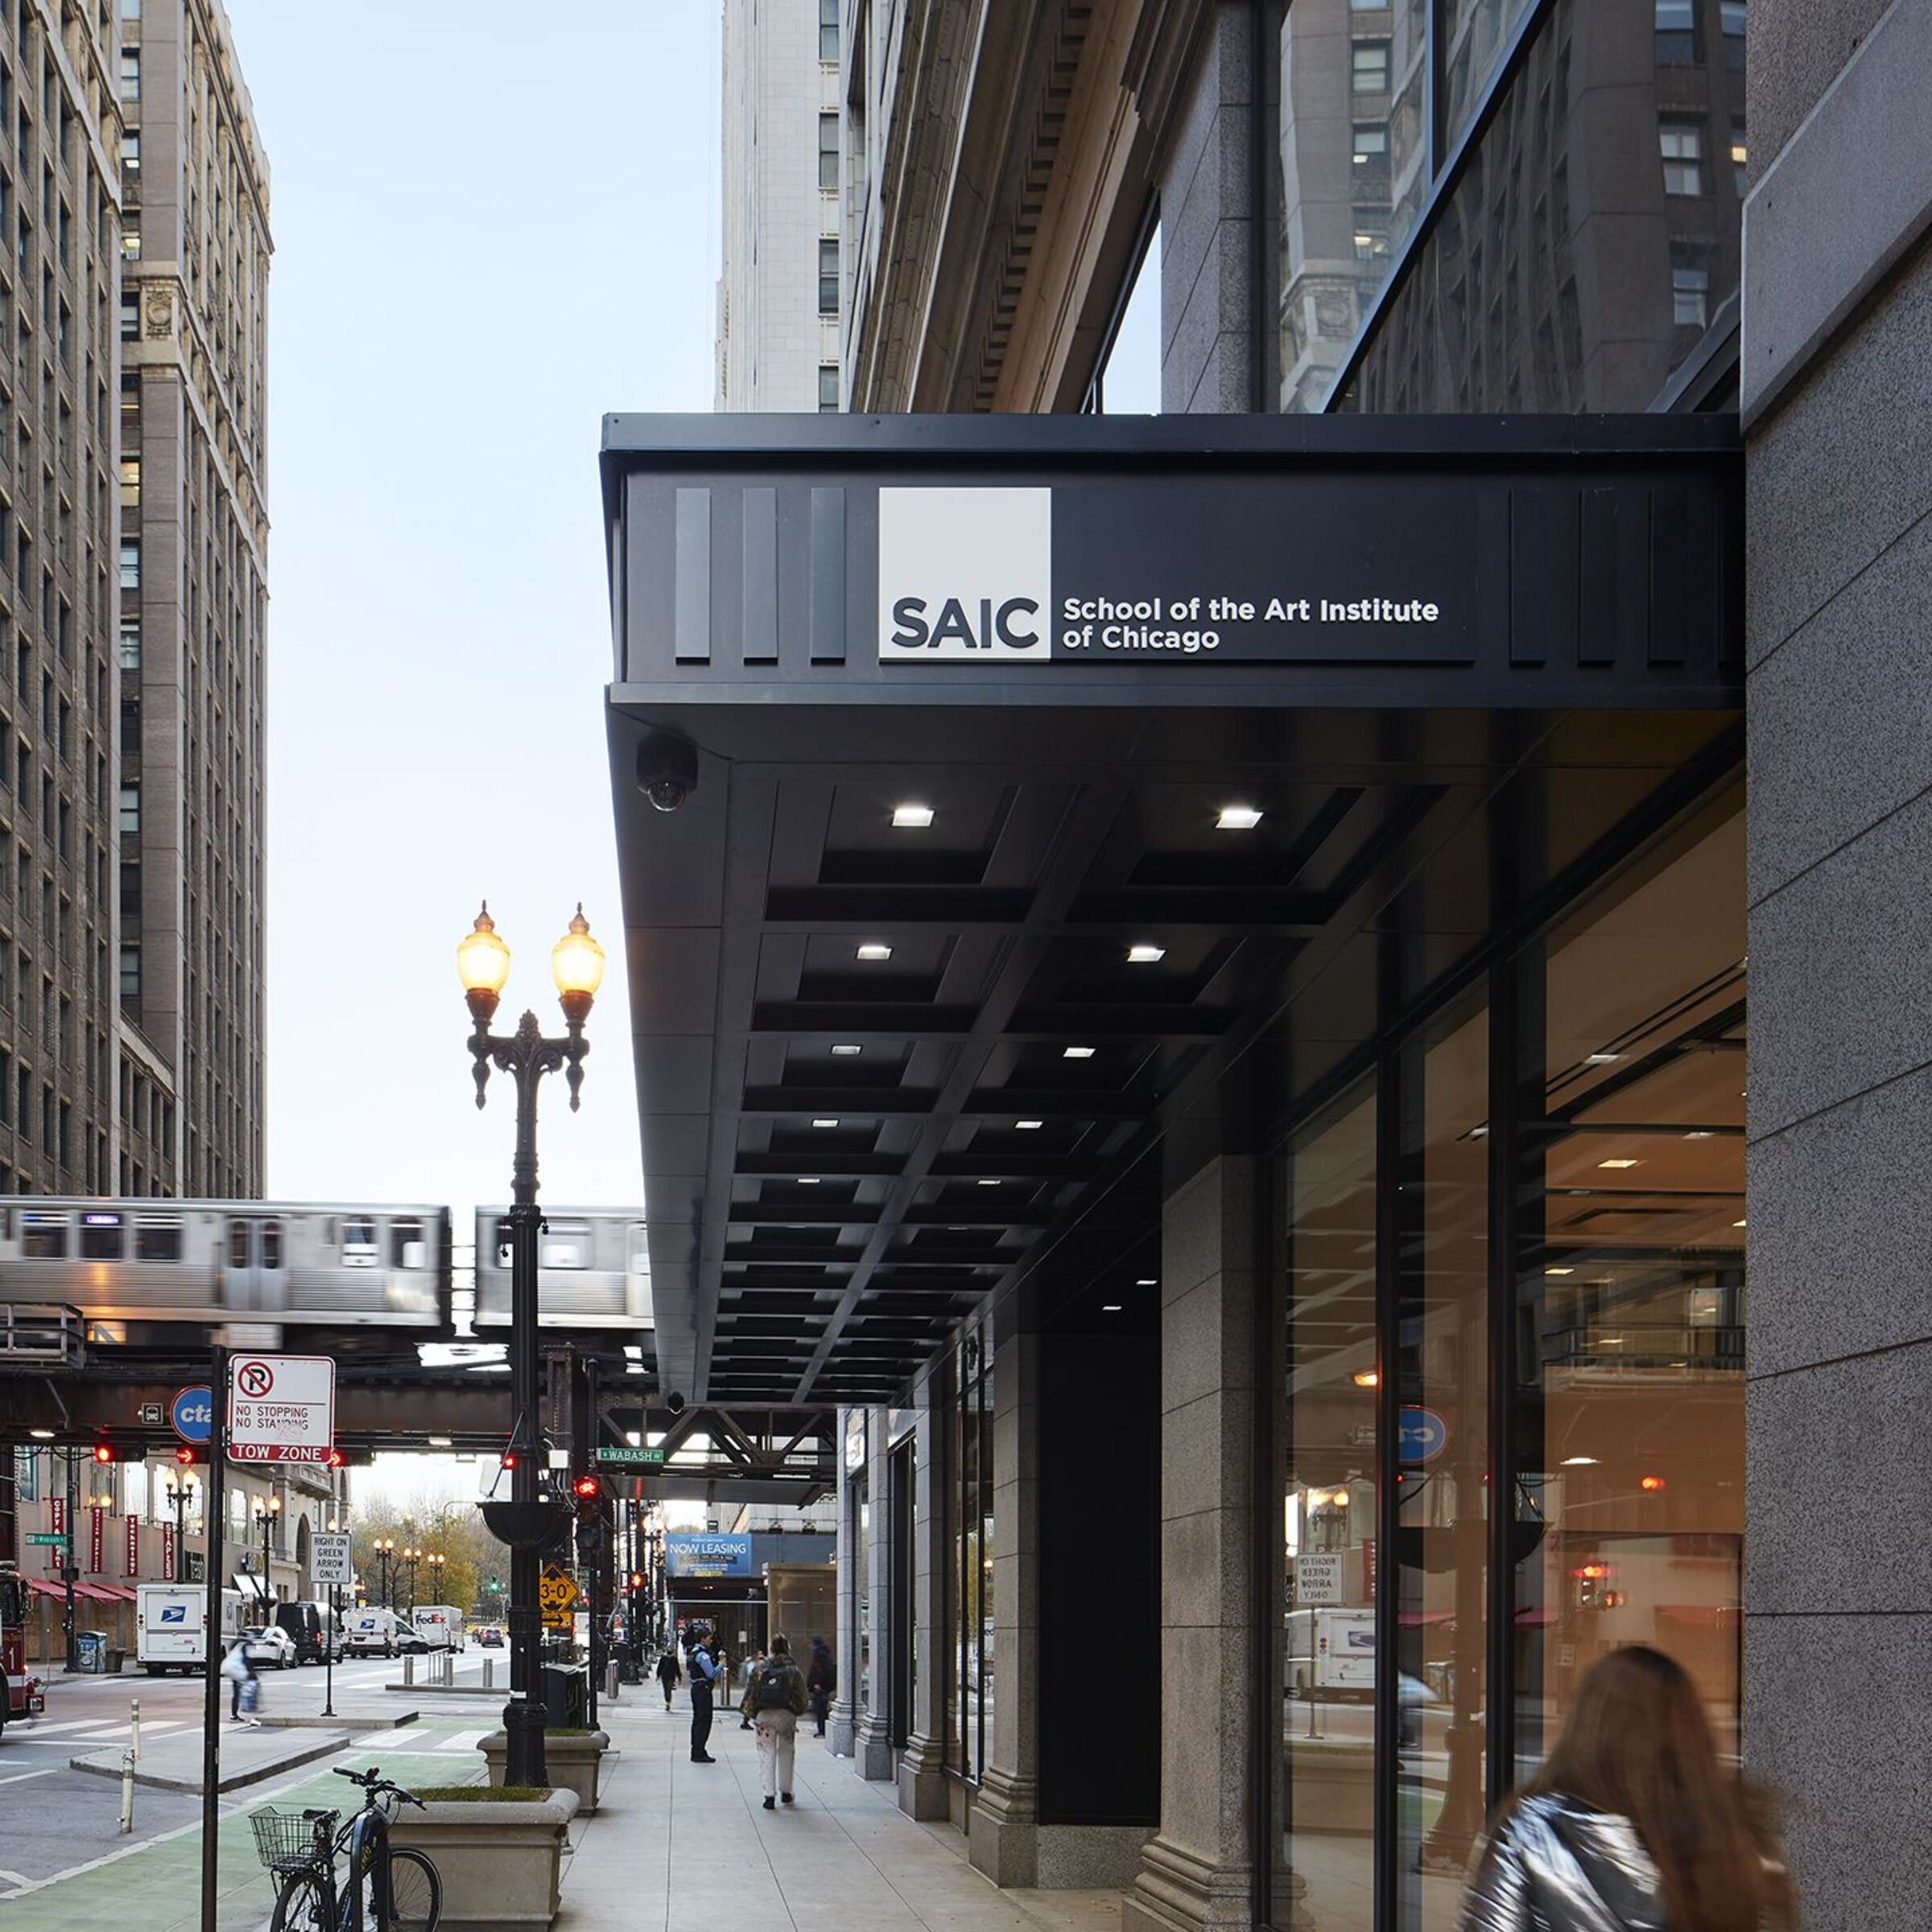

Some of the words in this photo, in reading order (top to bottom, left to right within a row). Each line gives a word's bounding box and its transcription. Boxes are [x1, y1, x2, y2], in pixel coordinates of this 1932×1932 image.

[1063, 597, 1161, 621] School
[1170, 597, 1200, 621] of
[1209, 597, 1256, 621] the
[1264, 599, 1311, 621] Art
[1321, 599, 1439, 622] Institute
[891, 597, 1040, 648] SAIC
[1063, 626, 1092, 649] of
[1102, 626, 1220, 653] Chicago
[236, 1406, 251, 1417] NO
[257, 1406, 308, 1418] STOPPING
[236, 1418, 251, 1428] NO
[236, 1445, 270, 1459] TOW
[279, 1446, 322, 1460] ZONE
[609, 1451, 652, 1461] WABASH
[314, 1537, 334, 1546] RIGHT
[336, 1538, 347, 1546] ON
[317, 1548, 344, 1557] GREEN
[670, 1543, 699, 1554] NOW
[702, 1543, 746, 1554] LEASING
[316, 1559, 343, 1567] ARROW
[319, 1570, 341, 1579] ONLY
[415, 1614, 446, 1624] FedEx
